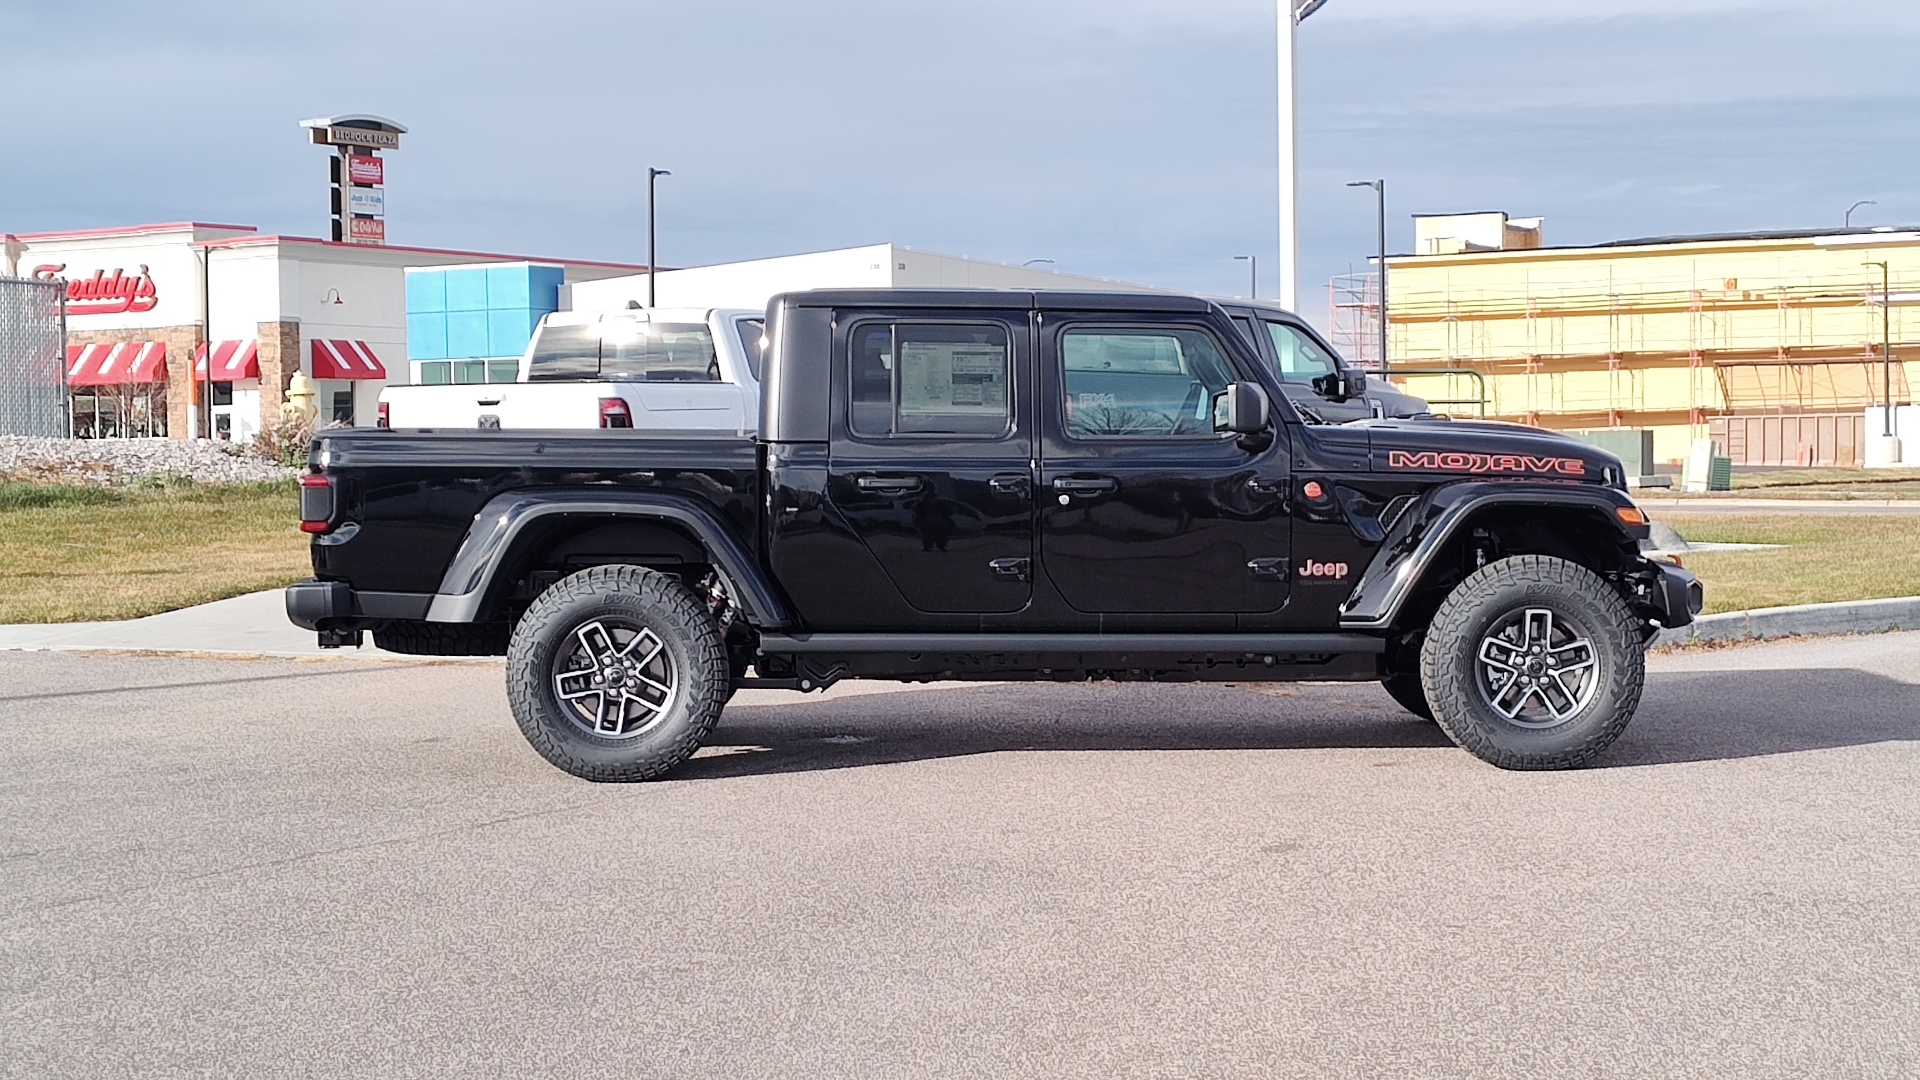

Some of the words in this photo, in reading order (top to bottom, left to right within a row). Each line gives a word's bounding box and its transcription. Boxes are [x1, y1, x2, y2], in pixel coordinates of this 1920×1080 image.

[335, 129, 371, 143] BEDROCK
[373, 134, 397, 145] PLAZA
[1079, 393, 1117, 409] FX4
[1389, 450, 1585, 475] MOJAVE
[1299, 559, 1348, 579] Jeep
